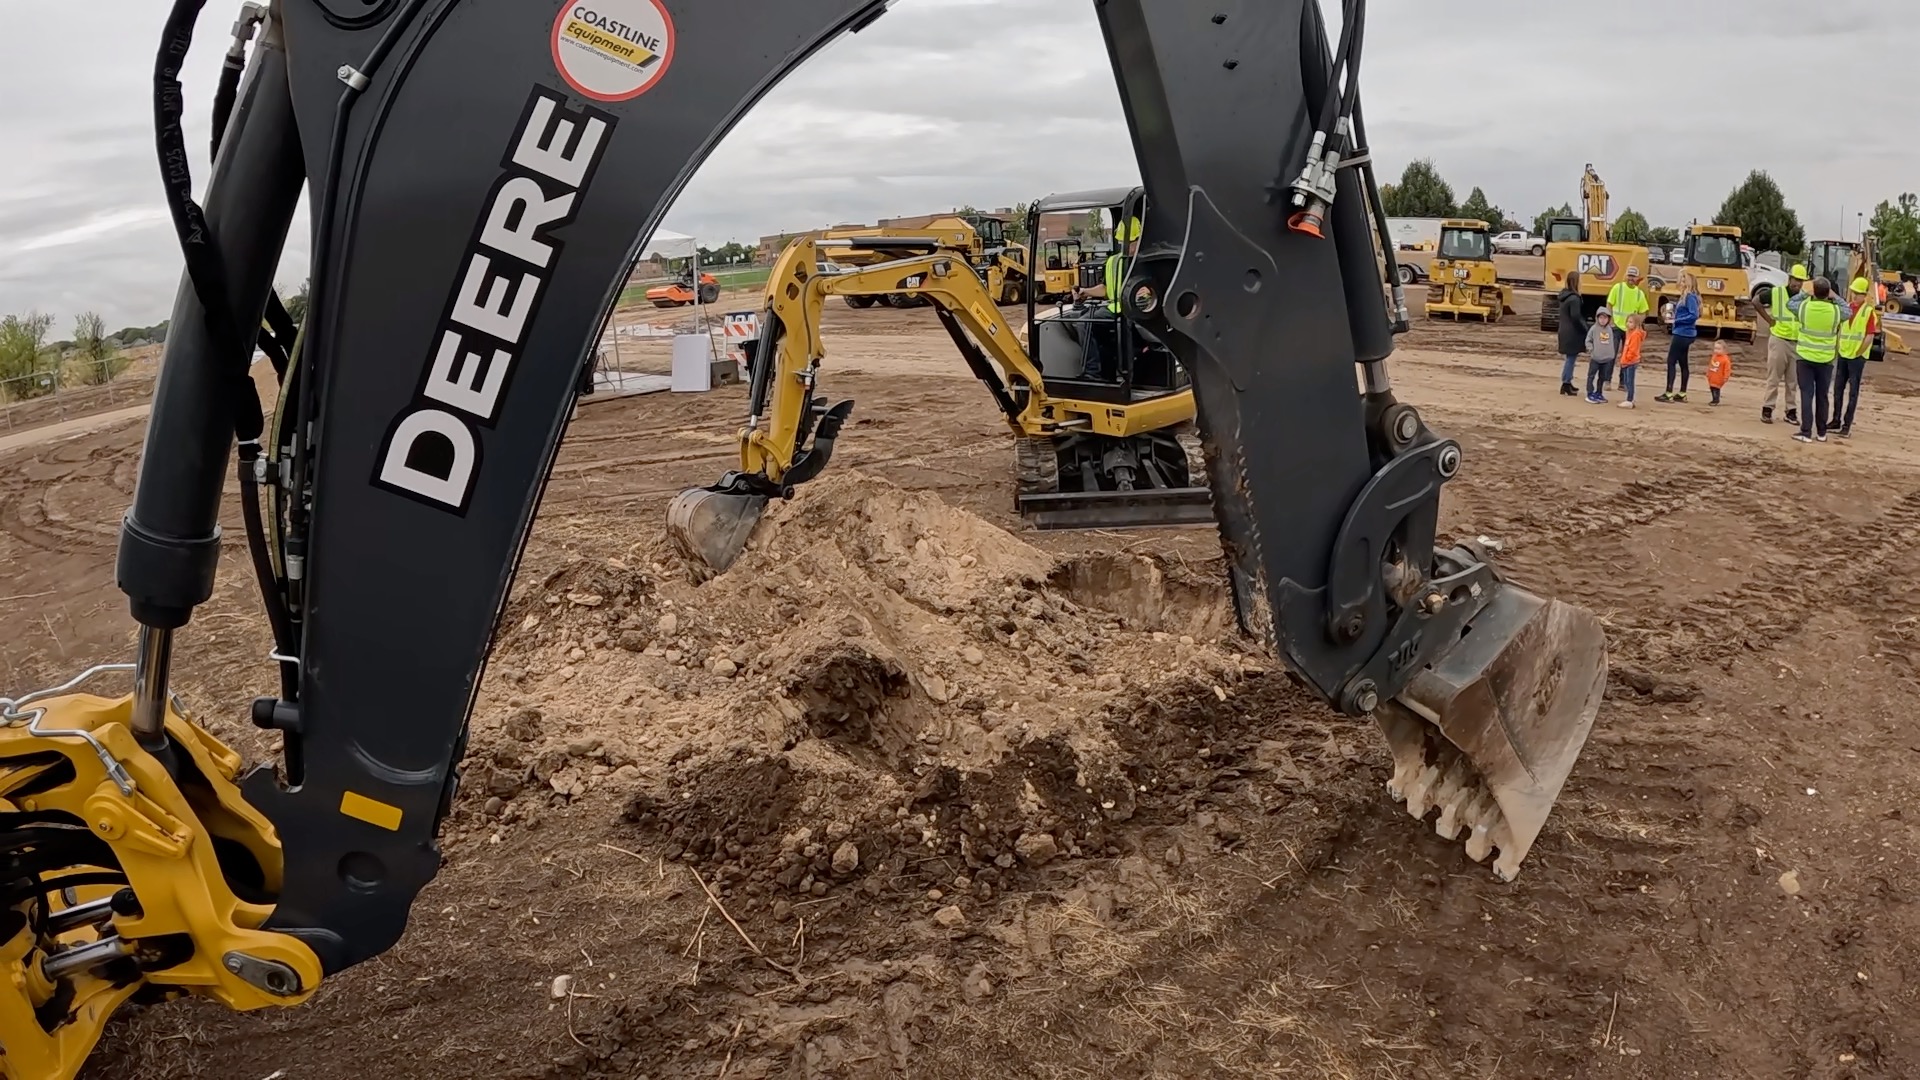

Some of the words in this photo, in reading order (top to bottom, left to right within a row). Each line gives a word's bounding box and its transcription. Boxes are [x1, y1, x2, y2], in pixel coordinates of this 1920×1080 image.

[567, 22, 635, 58] Equipment
[573, 6, 660, 52] COASTLINE
[560, 35, 644, 74] www.coastlineequipment.com
[1453, 268, 1469, 280] CAT
[1578, 253, 1610, 275] CAT
[906, 276, 921, 288] CAT
[1706, 279, 1723, 290] CAT
[379, 95, 607, 508] DEERE
